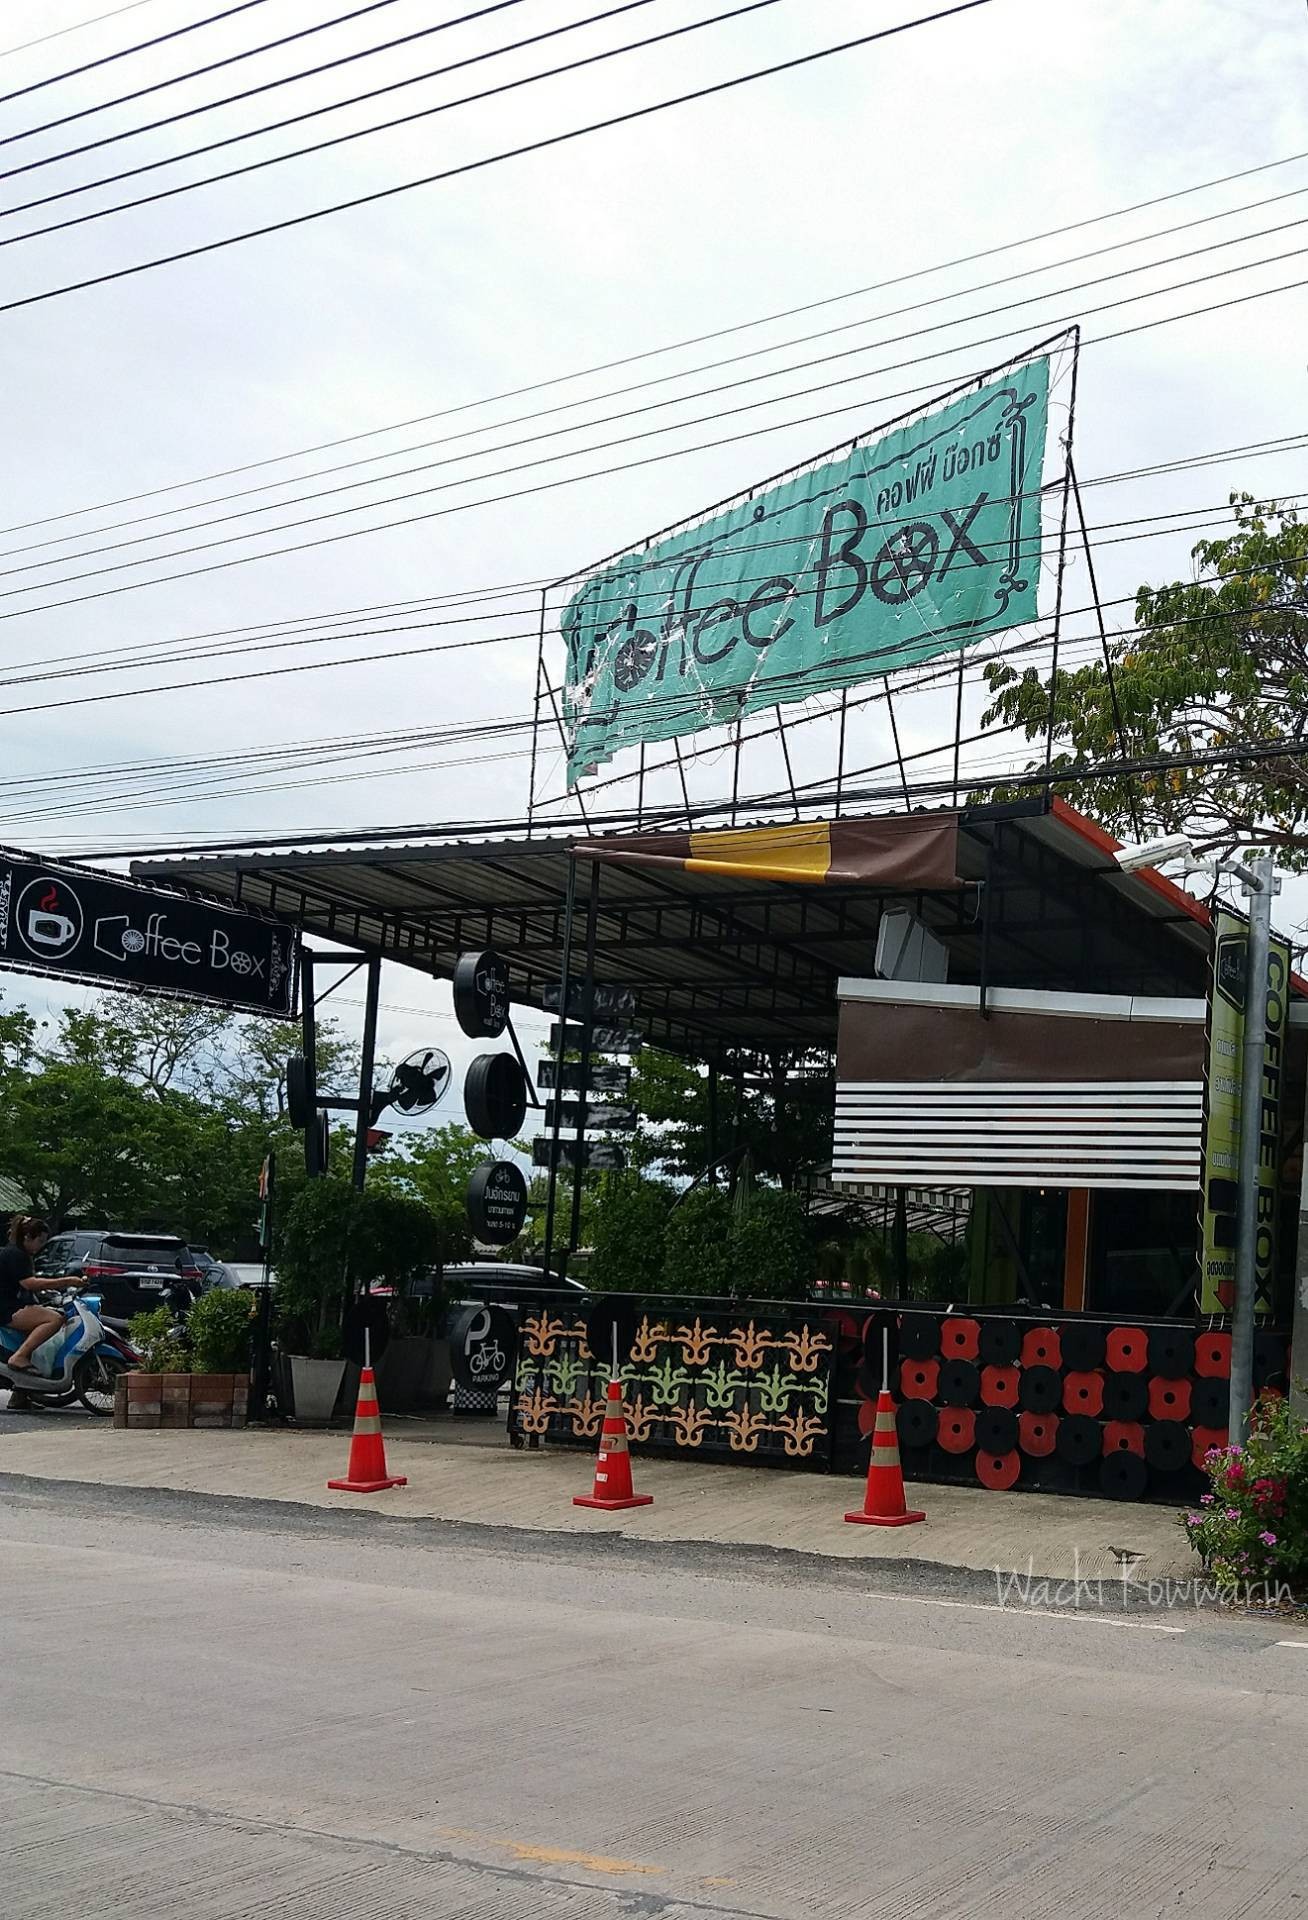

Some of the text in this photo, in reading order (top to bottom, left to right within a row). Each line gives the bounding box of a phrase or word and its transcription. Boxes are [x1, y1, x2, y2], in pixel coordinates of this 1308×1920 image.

[93, 913, 265, 979] Coffee Box
[1255, 951, 1284, 1307] COFFEE BOX
